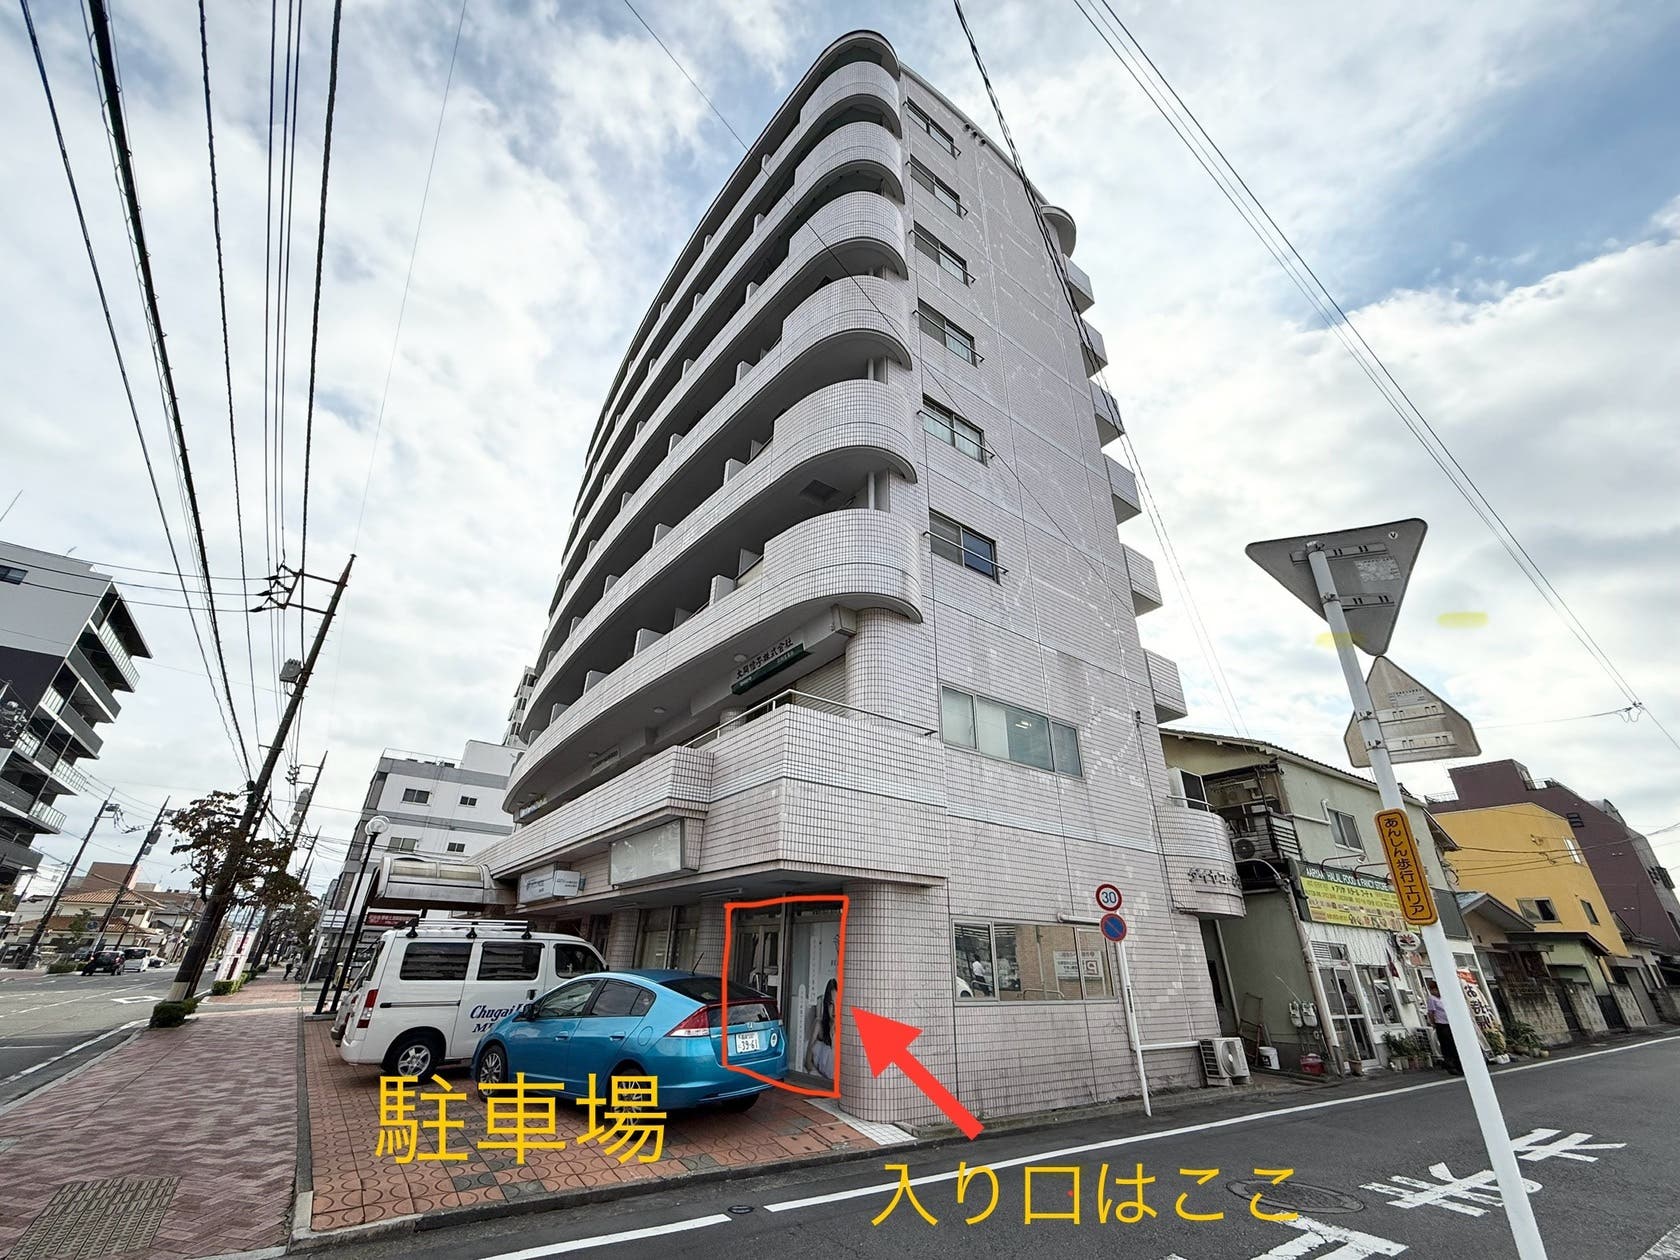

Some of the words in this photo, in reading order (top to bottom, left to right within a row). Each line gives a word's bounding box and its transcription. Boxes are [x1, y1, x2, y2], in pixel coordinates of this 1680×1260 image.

[1384, 817, 1425, 916] あんしん歩行エリア
[1101, 891, 1117, 903] 30
[470, 1004, 516, 1021] Chugai
